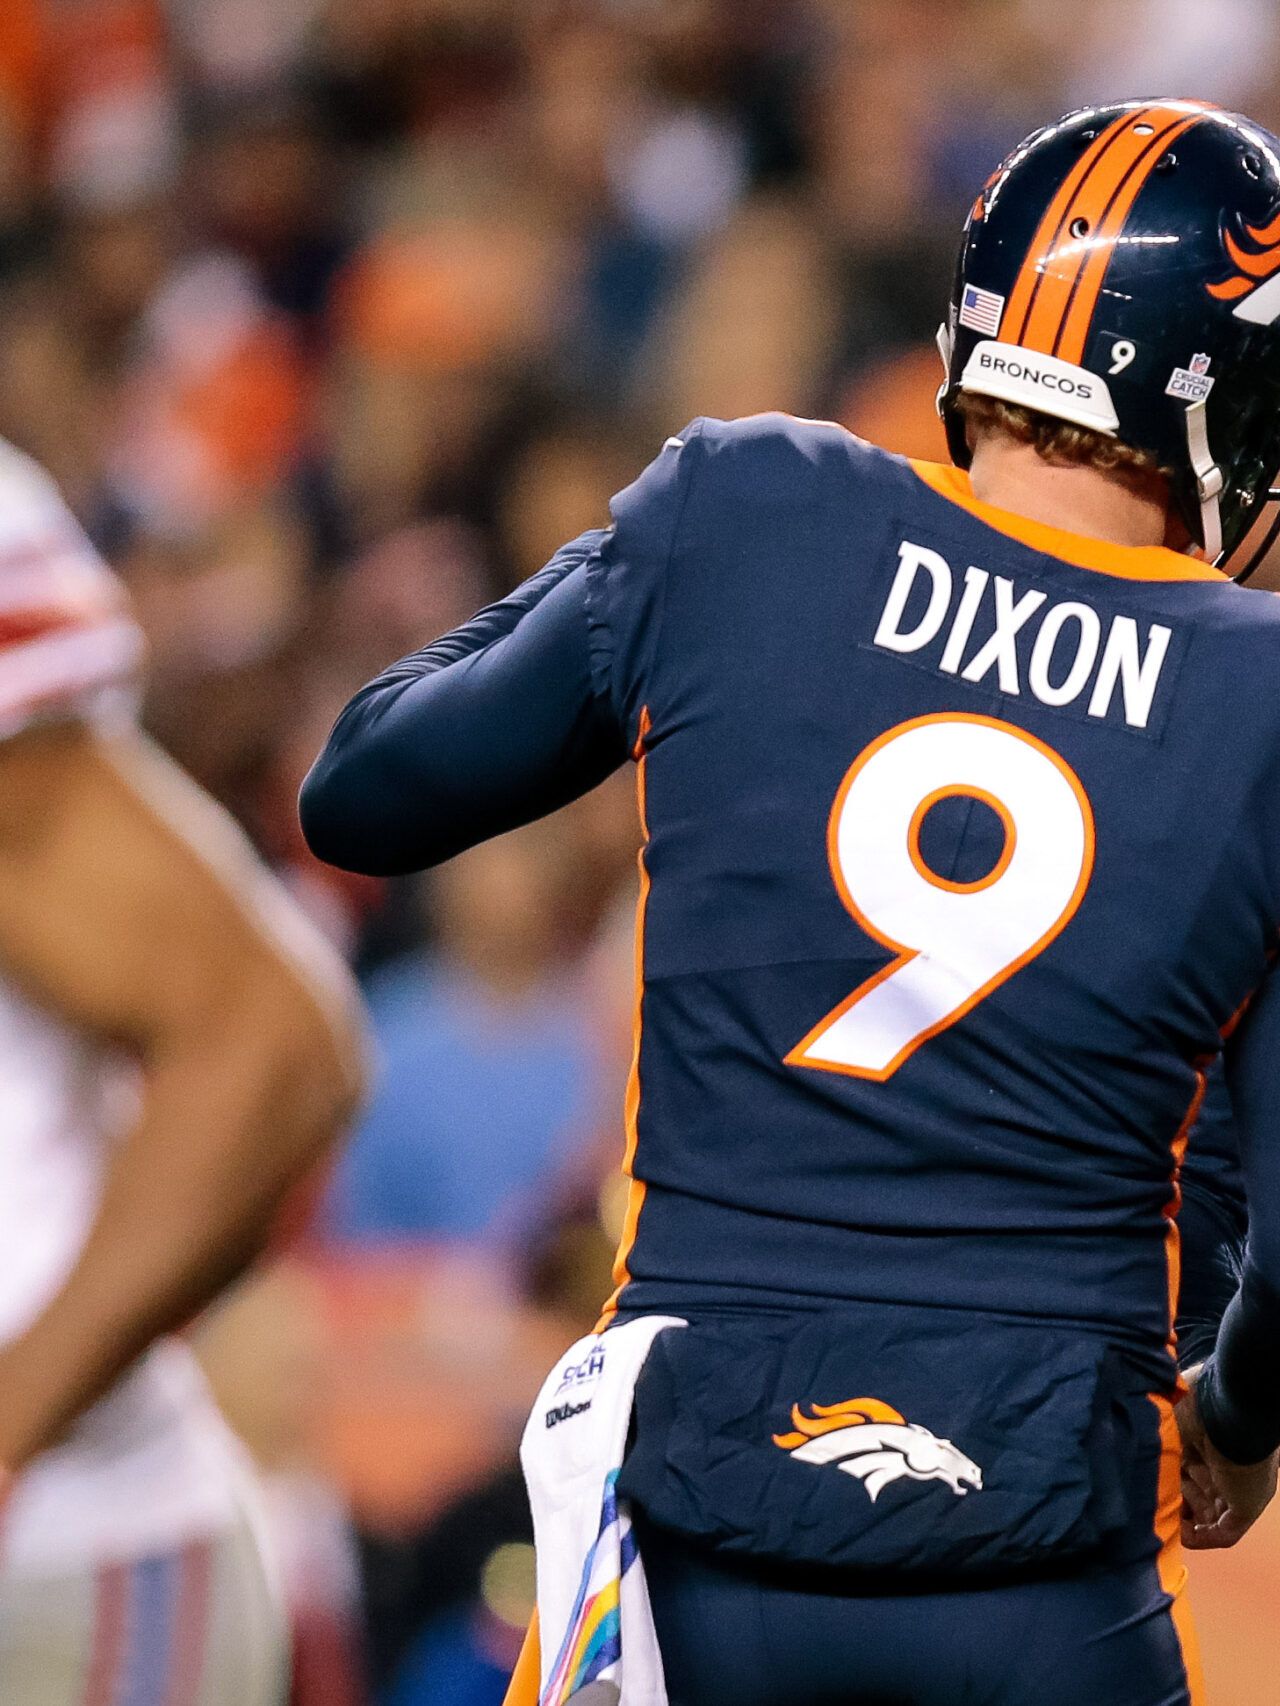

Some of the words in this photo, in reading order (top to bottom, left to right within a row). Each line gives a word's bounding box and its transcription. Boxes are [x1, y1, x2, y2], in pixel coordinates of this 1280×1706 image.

[979, 353, 1093, 399] BRONCOS
[1107, 340, 1136, 375] 9
[1171, 380, 1207, 397] CATCH
[873, 540, 1172, 728] DIXON
[782, 711, 1096, 1082] 9
